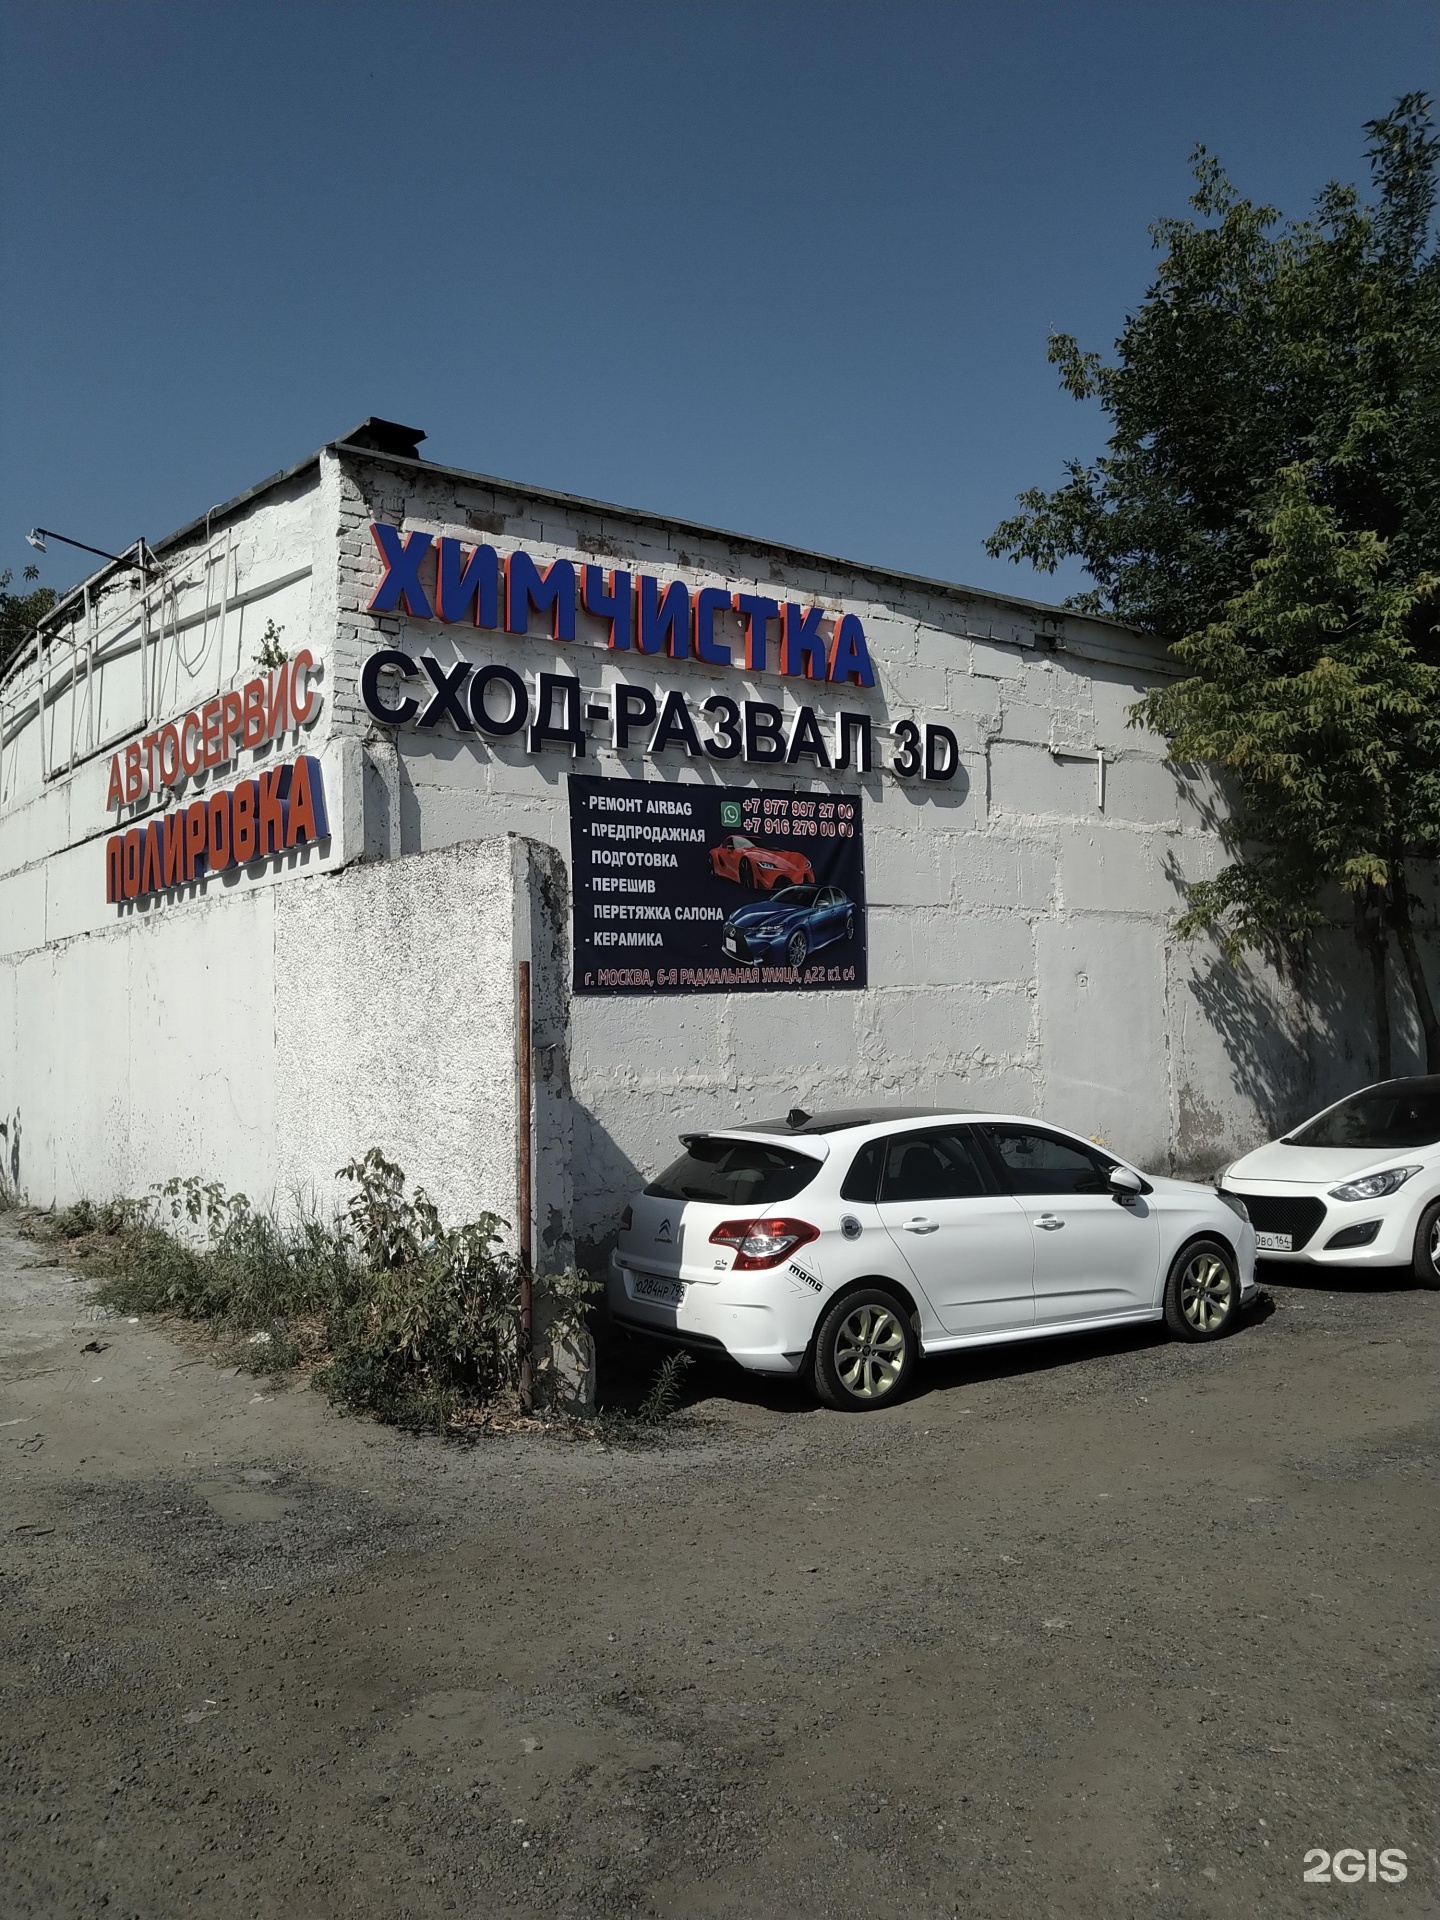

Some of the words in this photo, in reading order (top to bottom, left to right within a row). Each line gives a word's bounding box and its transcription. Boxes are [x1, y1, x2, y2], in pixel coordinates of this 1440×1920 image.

[367, 523, 876, 688] ХИМЧИСТКА
[359, 650, 872, 773] СХОД-РАЗВАЛ
[890, 720, 960, 781] 3D
[106, 648, 324, 812] АВТОСЕРВИС
[589, 795, 643, 813] РЕМОНТ
[646, 800, 693, 816] AIRBAG
[743, 798, 761, 814] +7
[764, 799, 788, 816] 977
[792, 801, 816, 817] 997
[819, 803, 835, 818] 27
[837, 804, 854, 819] 00
[106, 755, 331, 904] ПОЛИРОВКА
[591, 822, 706, 843] ПРЕДПРОДАЖНАЯ
[743, 817, 761, 833] +7
[764, 818, 790, 834] 916
[793, 820, 817, 836] 279
[820, 821, 836, 836] 00
[838, 822, 854, 837] 00
[591, 850, 679, 868] ПОДГОТОВКА
[592, 877, 656, 893] ПЕРЕШИВ
[593, 904, 672, 920] ПЕРЕТЯЖКА
[674, 906, 725, 921] САЛОНА
[593, 931, 664, 947] КЕРАМИКА
[597, 968, 655, 987] МОСКВА,
[679, 967, 760, 987] РАДИАЛЬНАЯ
[788, 1264, 824, 1293] momo
